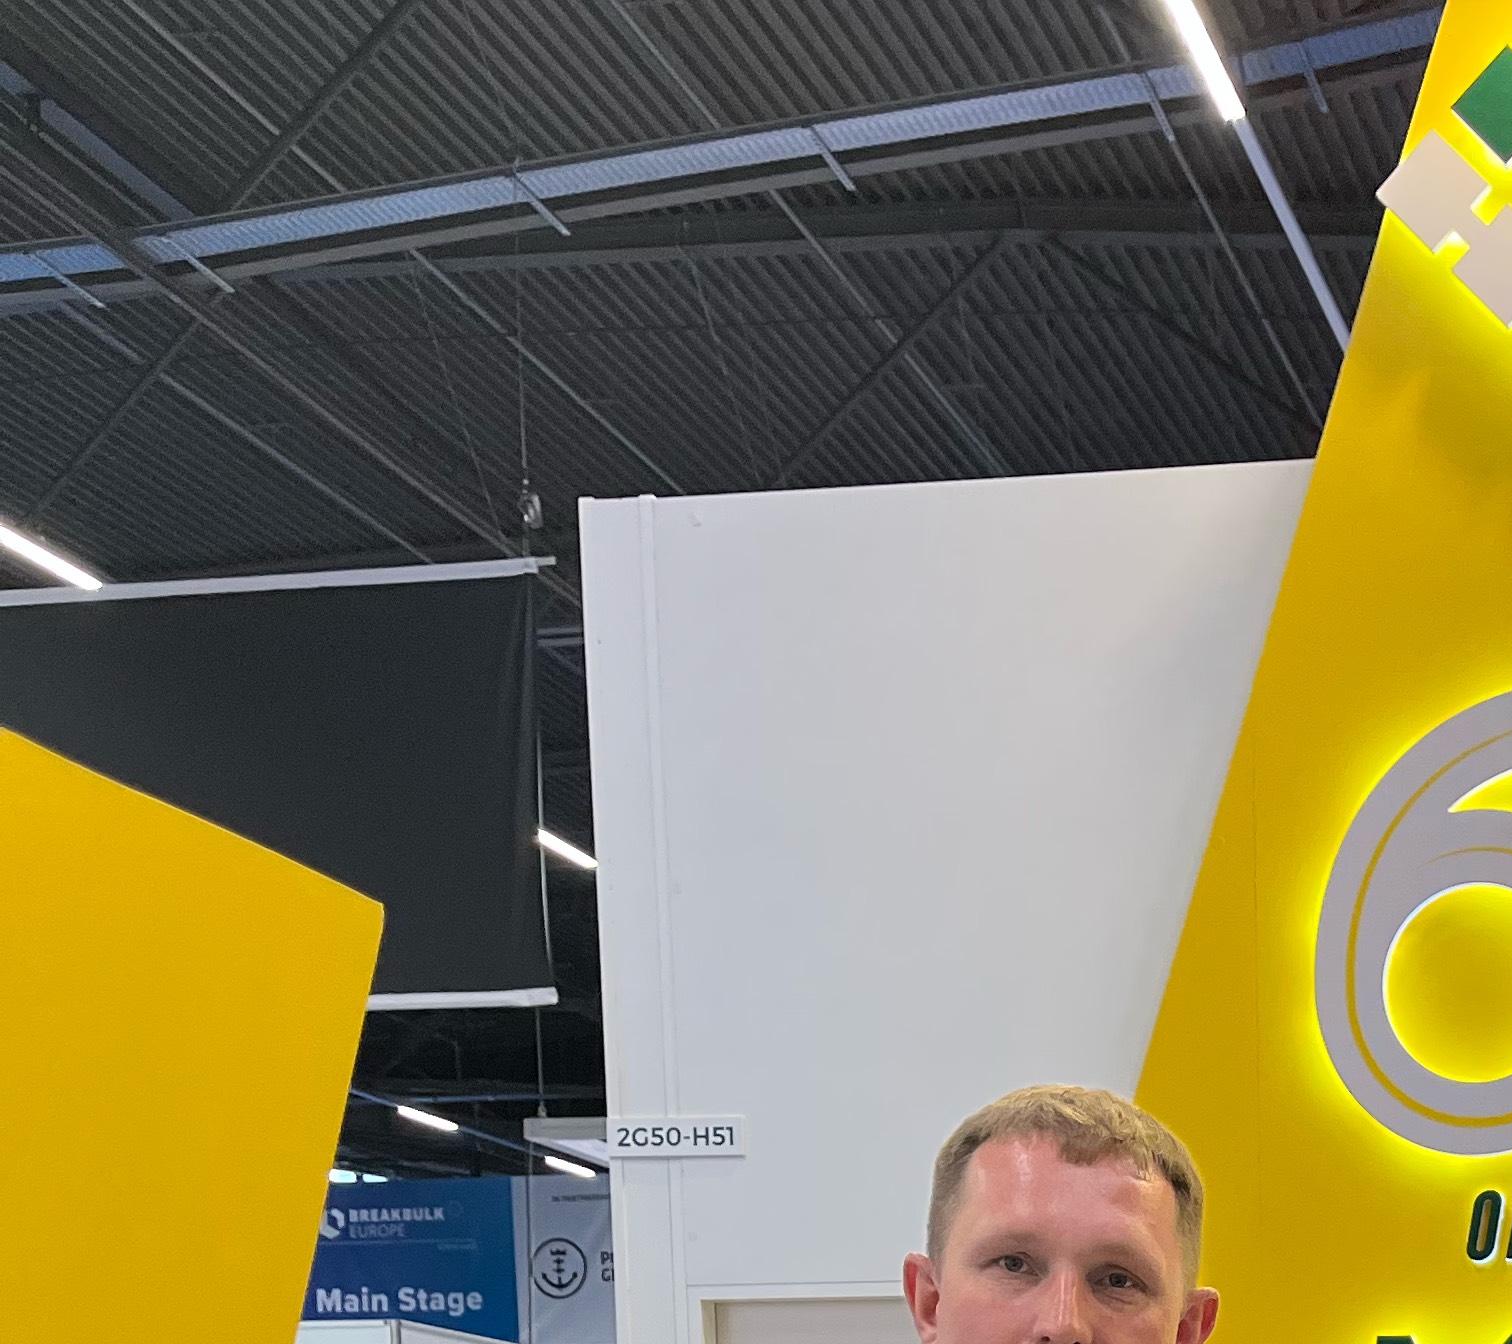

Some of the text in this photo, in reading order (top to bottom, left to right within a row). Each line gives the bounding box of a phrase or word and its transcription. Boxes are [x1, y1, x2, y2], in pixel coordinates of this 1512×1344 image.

[617, 1126, 734, 1147] 2G50-H51
[348, 1207, 445, 1223] BREAKBULK
[349, 1223, 405, 1239] EUROPE
[316, 1286, 484, 1317] Main Stage
